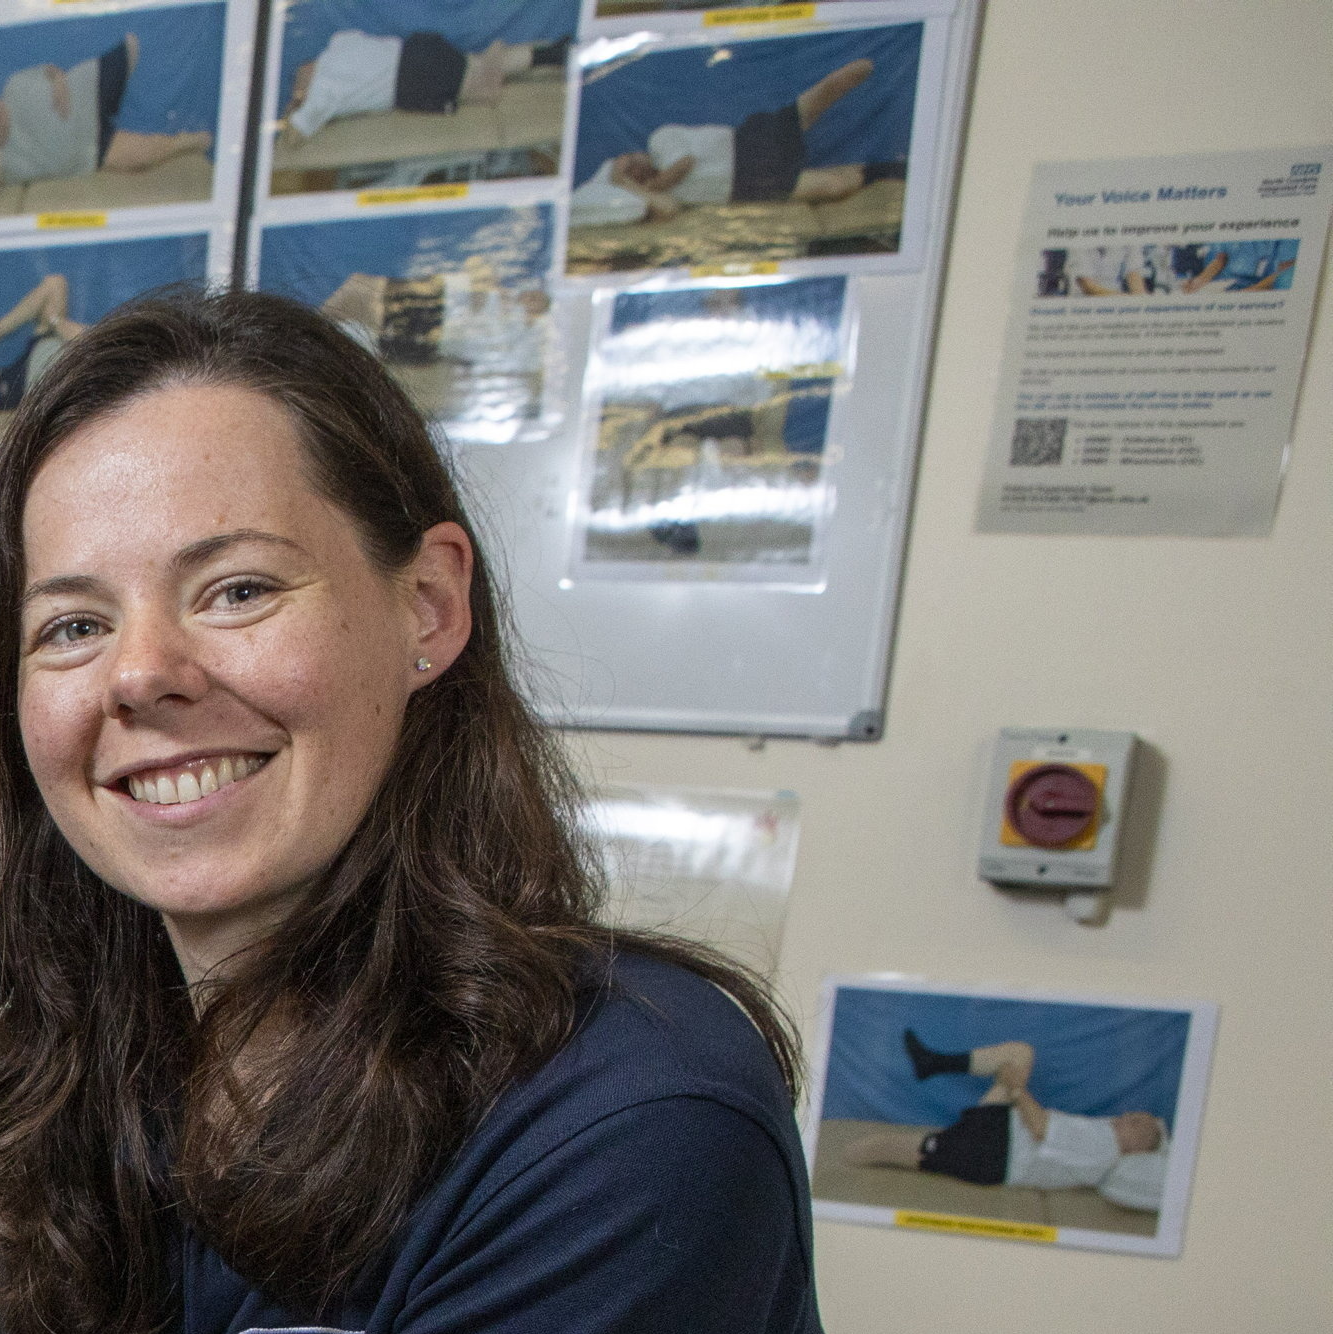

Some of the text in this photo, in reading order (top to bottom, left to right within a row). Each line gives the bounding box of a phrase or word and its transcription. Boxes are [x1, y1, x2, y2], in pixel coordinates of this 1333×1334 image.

[1054, 185, 1228, 206] Your Voice Matters
[1047, 227, 1079, 239] Help
[1121, 224, 1179, 237] improve
[1182, 221, 1216, 235] your
[1219, 218, 1300, 232] experience
